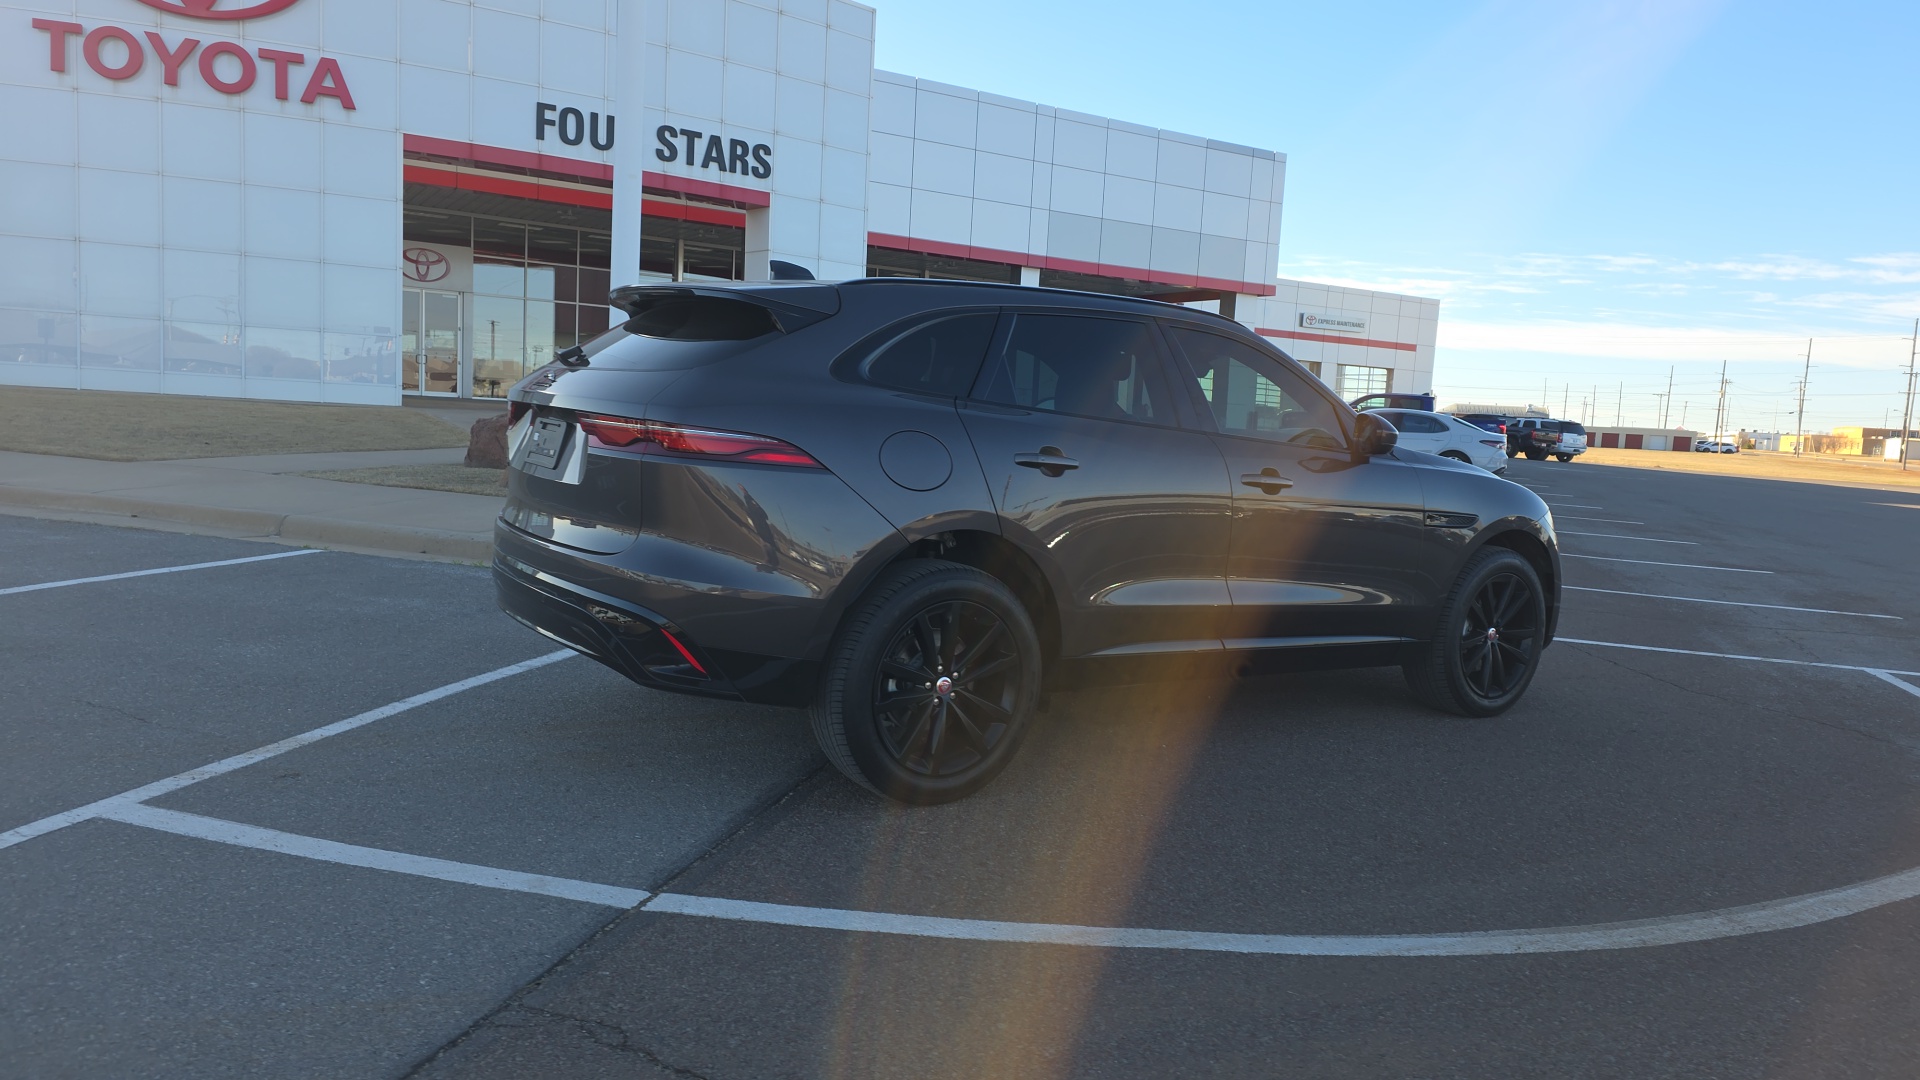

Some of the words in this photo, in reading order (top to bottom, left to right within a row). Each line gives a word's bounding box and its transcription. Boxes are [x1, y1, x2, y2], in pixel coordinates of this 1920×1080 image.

[32, 18, 356, 110] TOYOTA
[536, 102, 615, 151] FOU
[656, 125, 772, 179] STARS
[1317, 318, 1336, 326] EXPRESS
[1336, 320, 1366, 329] MAINTENANCE
